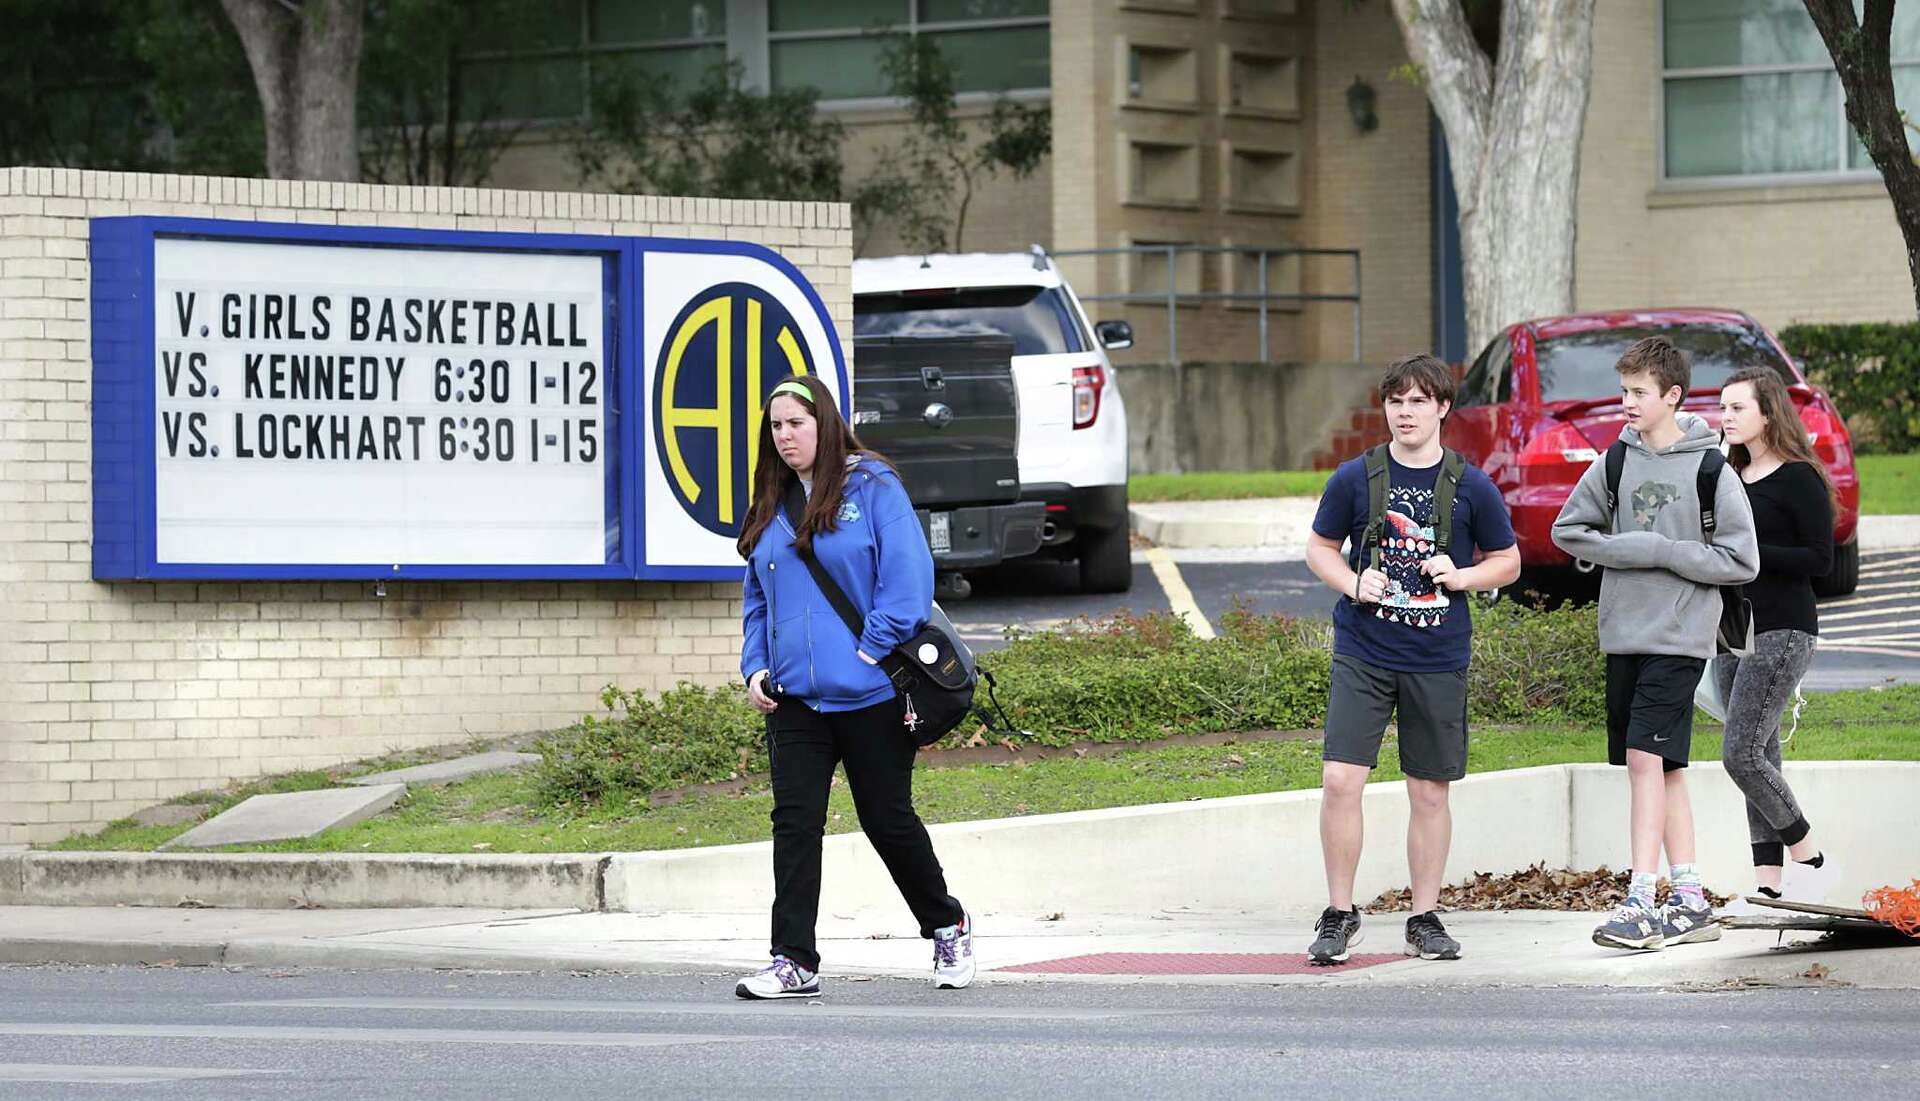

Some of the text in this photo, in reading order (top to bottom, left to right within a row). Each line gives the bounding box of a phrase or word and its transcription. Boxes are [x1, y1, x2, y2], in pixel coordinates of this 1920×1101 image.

[175, 291, 587, 348] V. GIRLS BASKETBALL
[162, 350, 597, 405] VS. KENNEDY 6:30 1-12
[162, 411, 597, 463] VS. LOCKHART 6:30 1-15
